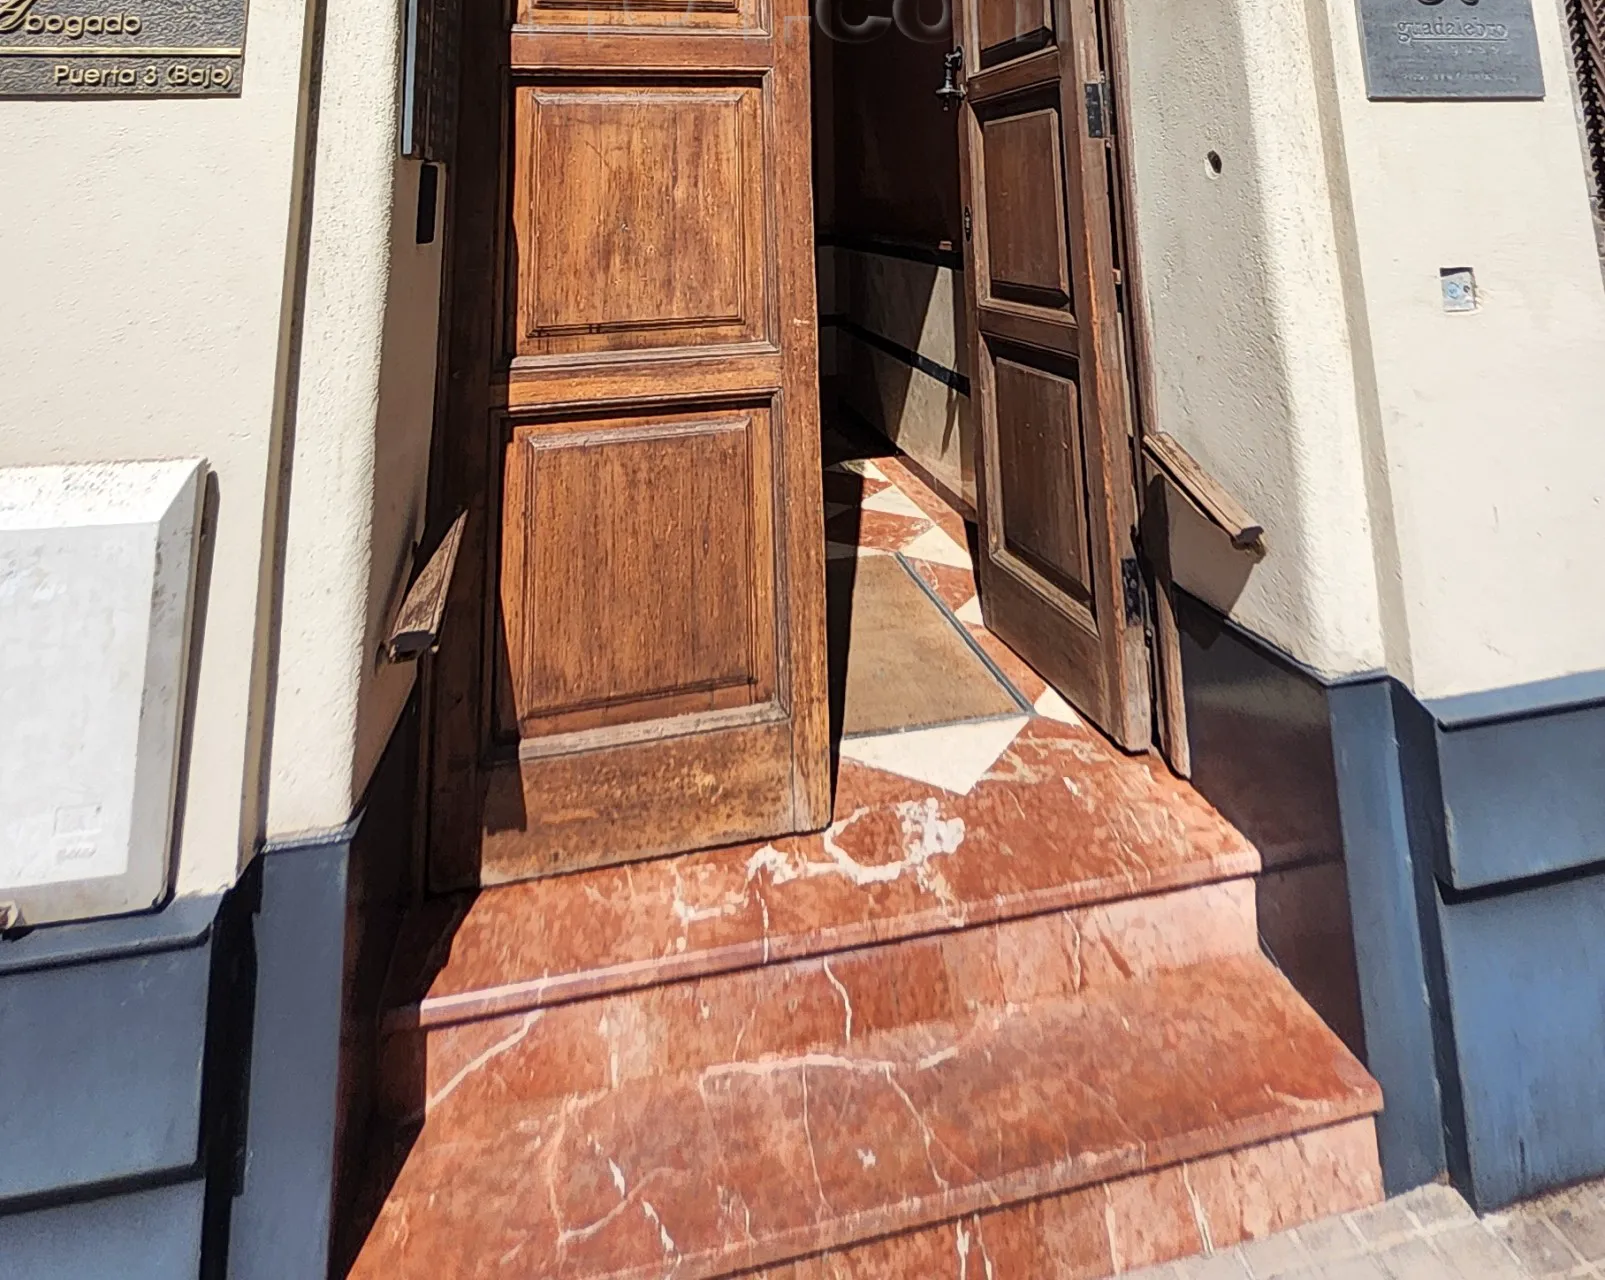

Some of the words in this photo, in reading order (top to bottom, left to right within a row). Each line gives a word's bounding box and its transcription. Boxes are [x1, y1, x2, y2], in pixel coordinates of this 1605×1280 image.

[53, 65, 136, 85] Puerta
[143, 66, 157, 84] 3
[167, 66, 233, 88] (Bajo)
